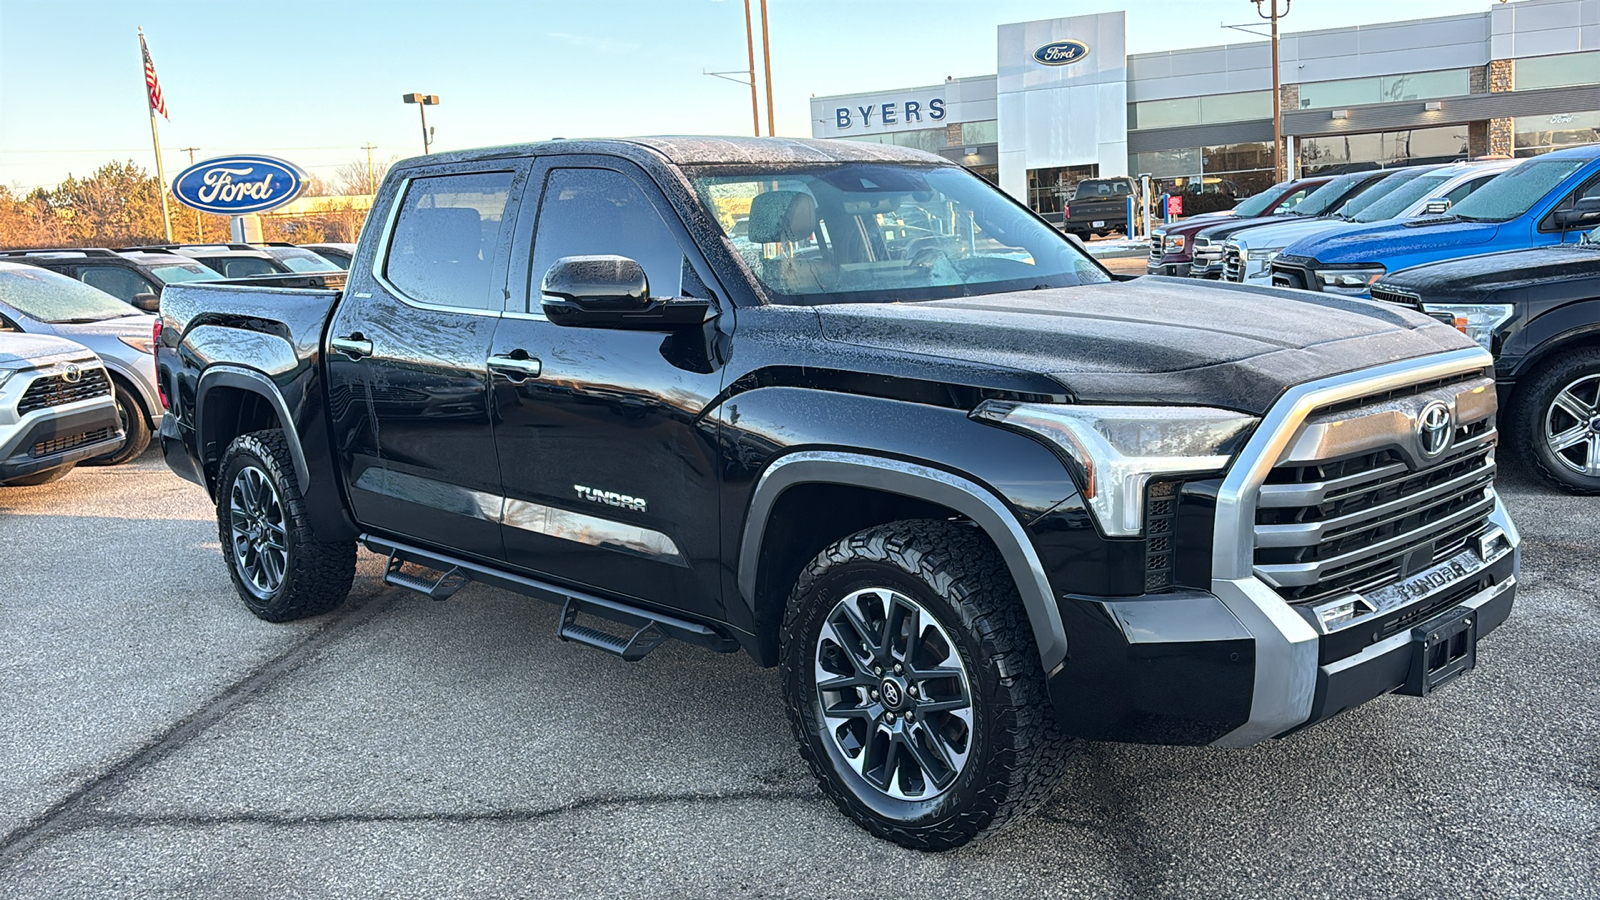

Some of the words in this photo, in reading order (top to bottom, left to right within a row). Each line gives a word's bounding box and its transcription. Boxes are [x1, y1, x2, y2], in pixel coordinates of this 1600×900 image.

[1044, 45, 1076, 61] Ford
[835, 98, 946, 129] BYERS
[1549, 114, 1575, 124] Ford
[198, 167, 274, 203] Ford
[573, 484, 647, 513] TUNDRA
[1398, 560, 1468, 602] TUNDRA
